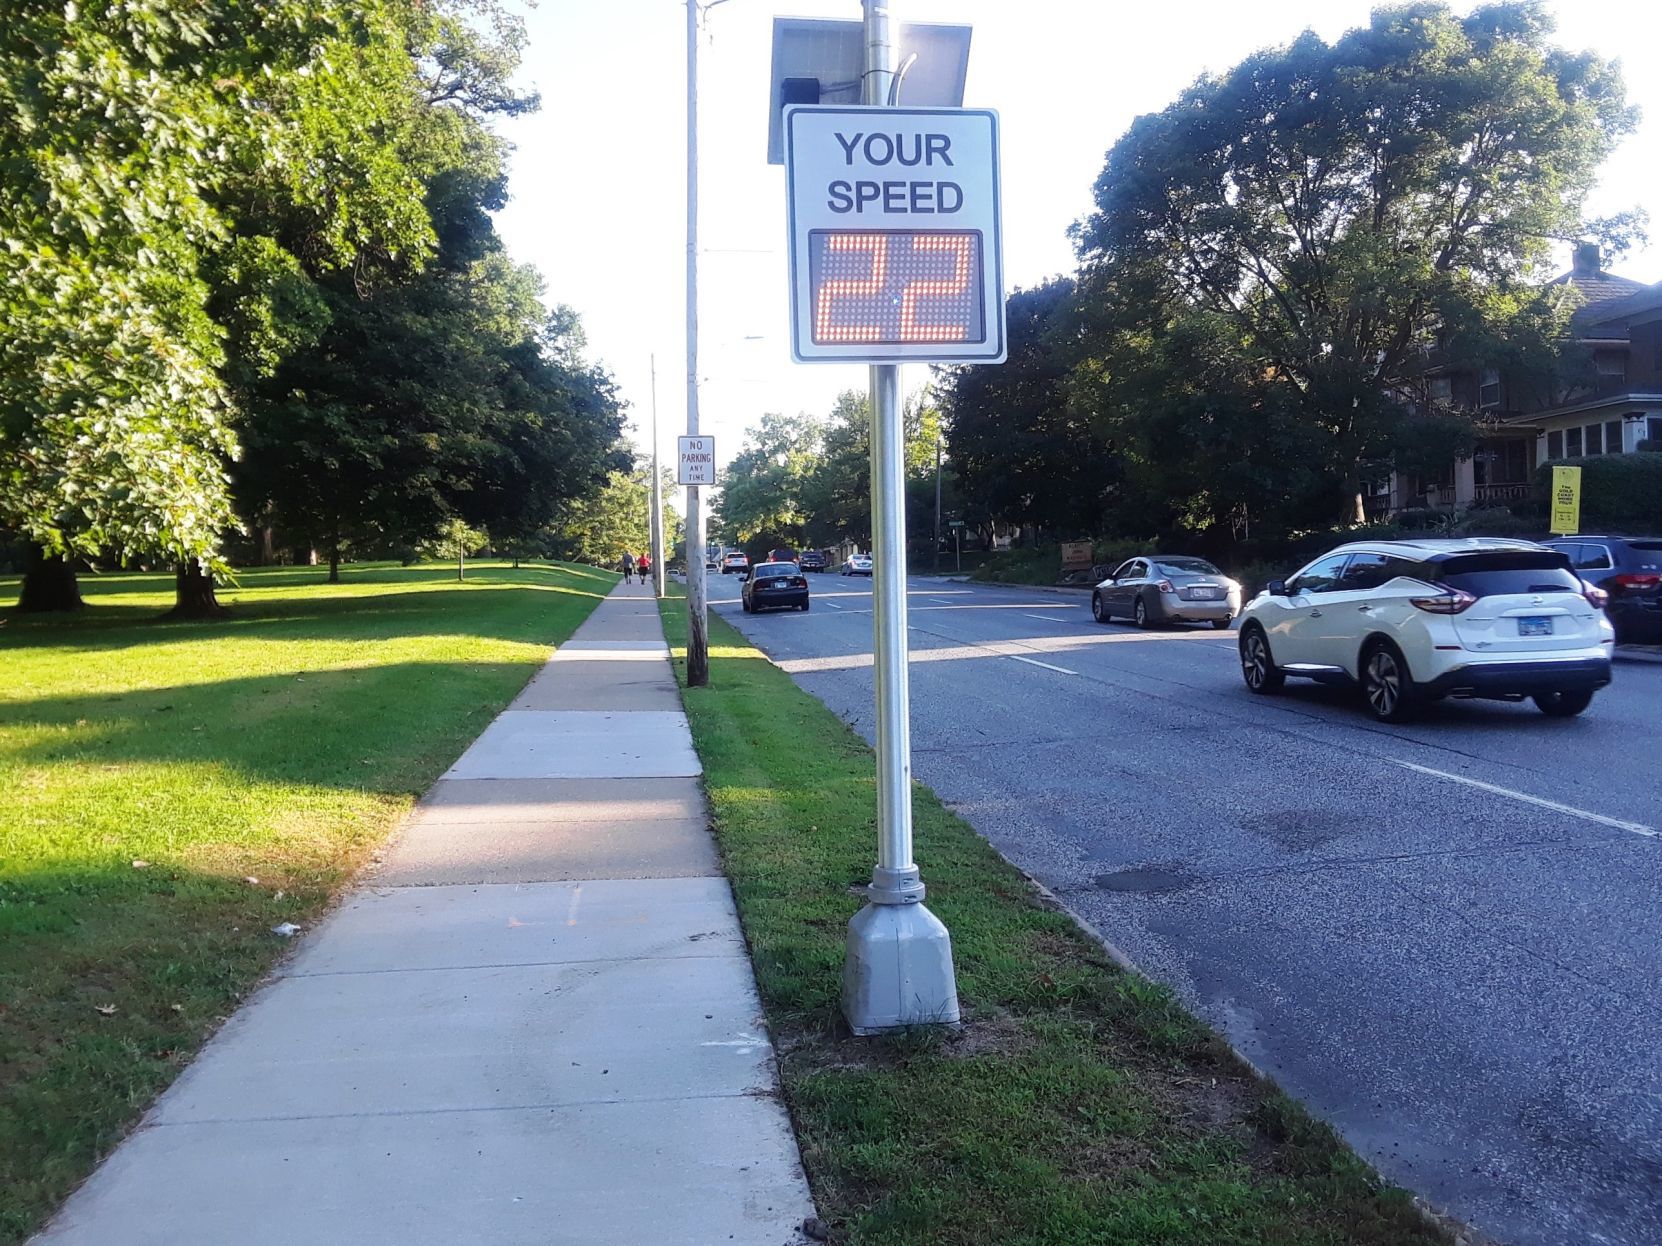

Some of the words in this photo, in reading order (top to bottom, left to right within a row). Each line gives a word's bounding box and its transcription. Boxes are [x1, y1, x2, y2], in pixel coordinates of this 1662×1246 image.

[834, 133, 954, 166] YOUR
[827, 180, 963, 214] SPEED
[816, 236, 970, 341] 22
[681, 453, 711, 463] PARKING
[690, 440, 703, 450] NO
